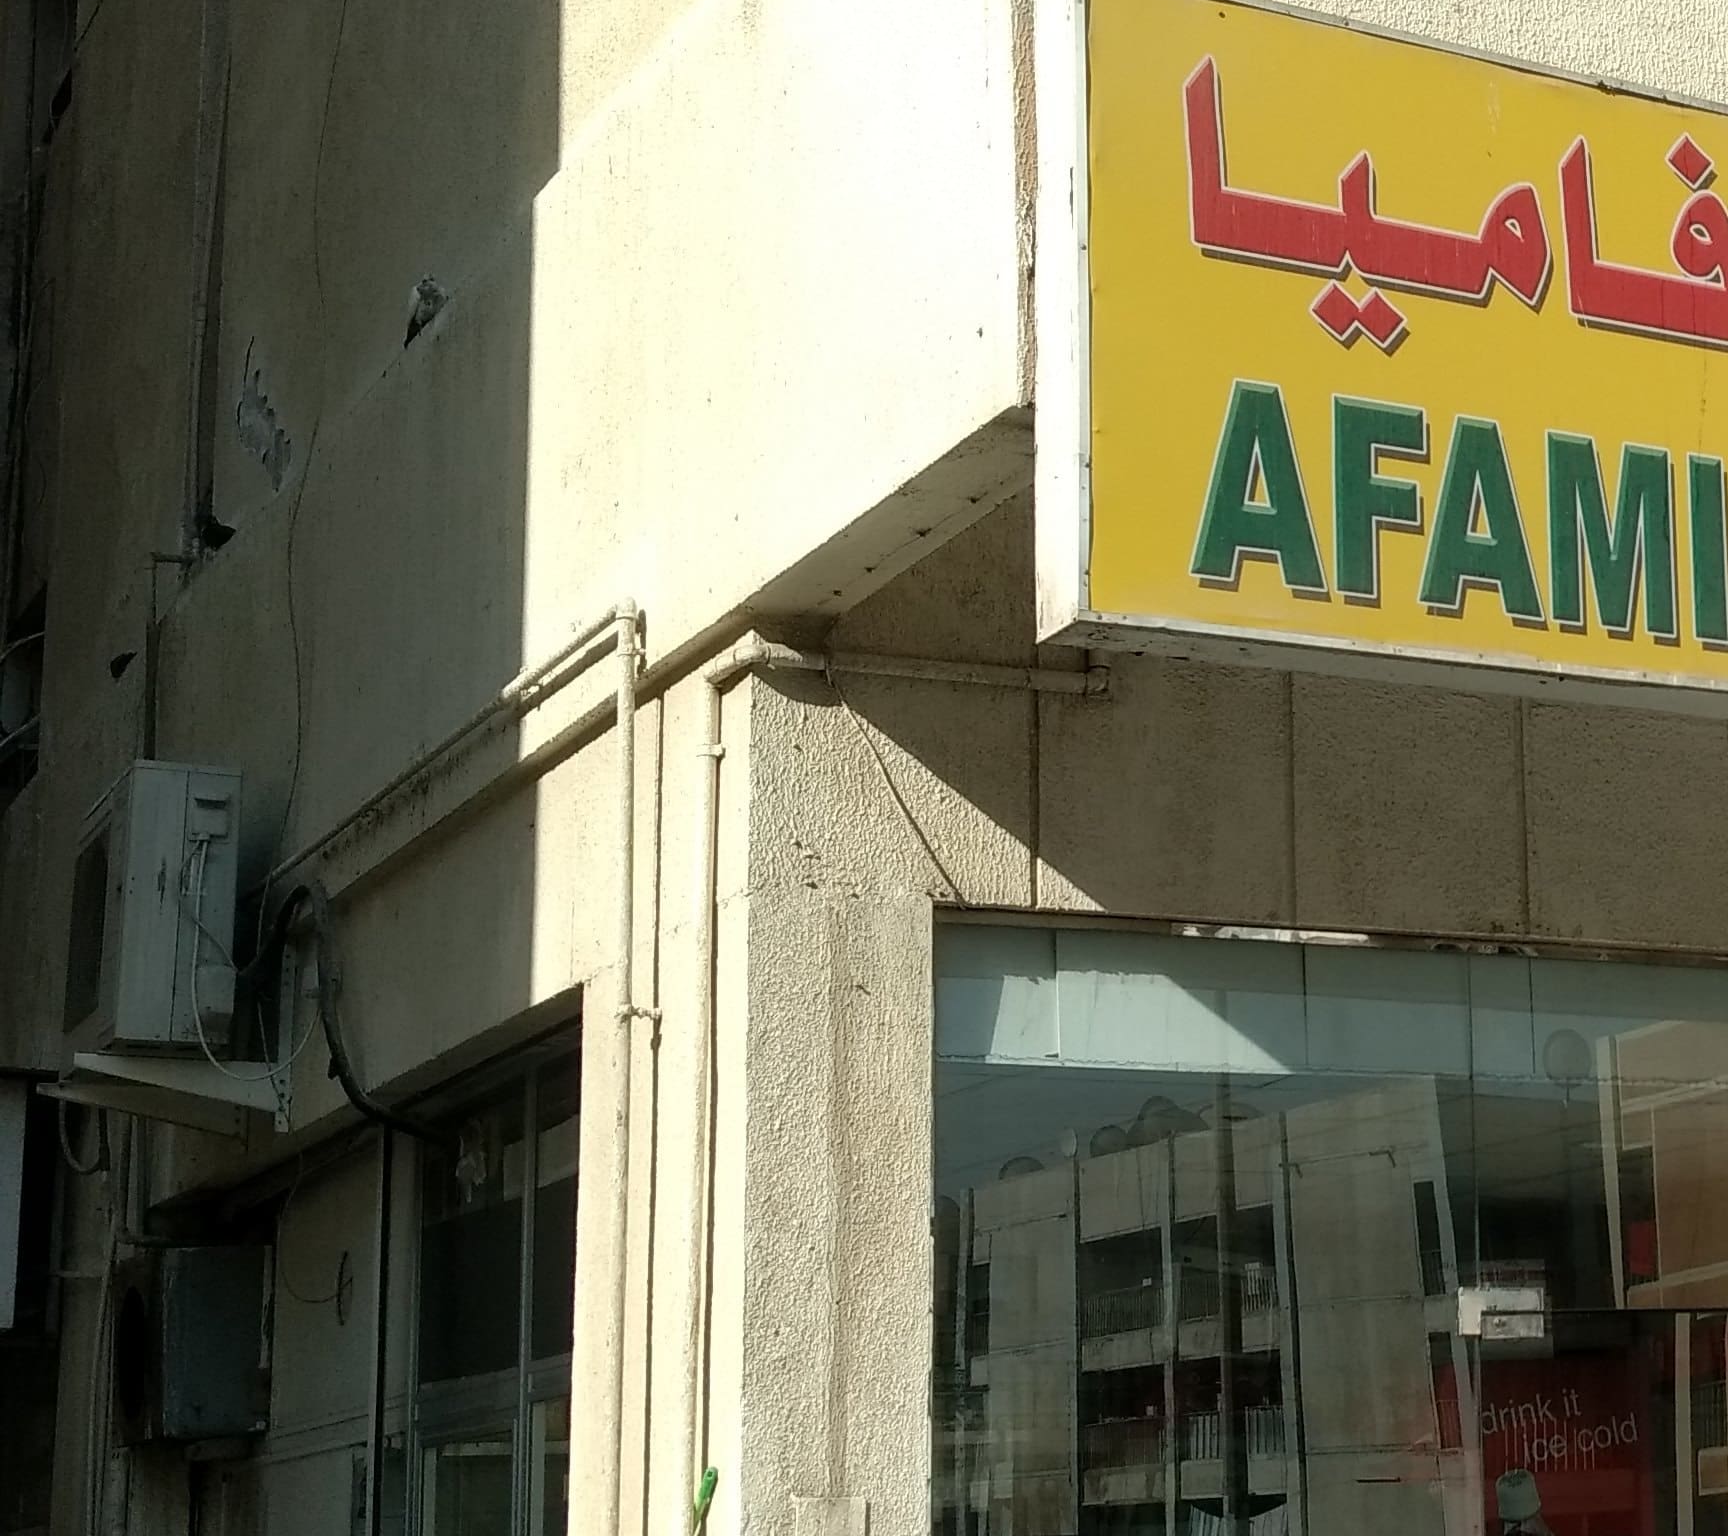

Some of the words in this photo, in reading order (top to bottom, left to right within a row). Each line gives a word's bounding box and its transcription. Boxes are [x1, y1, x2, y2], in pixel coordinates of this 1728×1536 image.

[1482, 1393, 1556, 1434] drink
[1562, 1388, 1581, 1417] it
[1523, 1432, 1568, 1464] ice
[1577, 1414, 1639, 1452] cold
